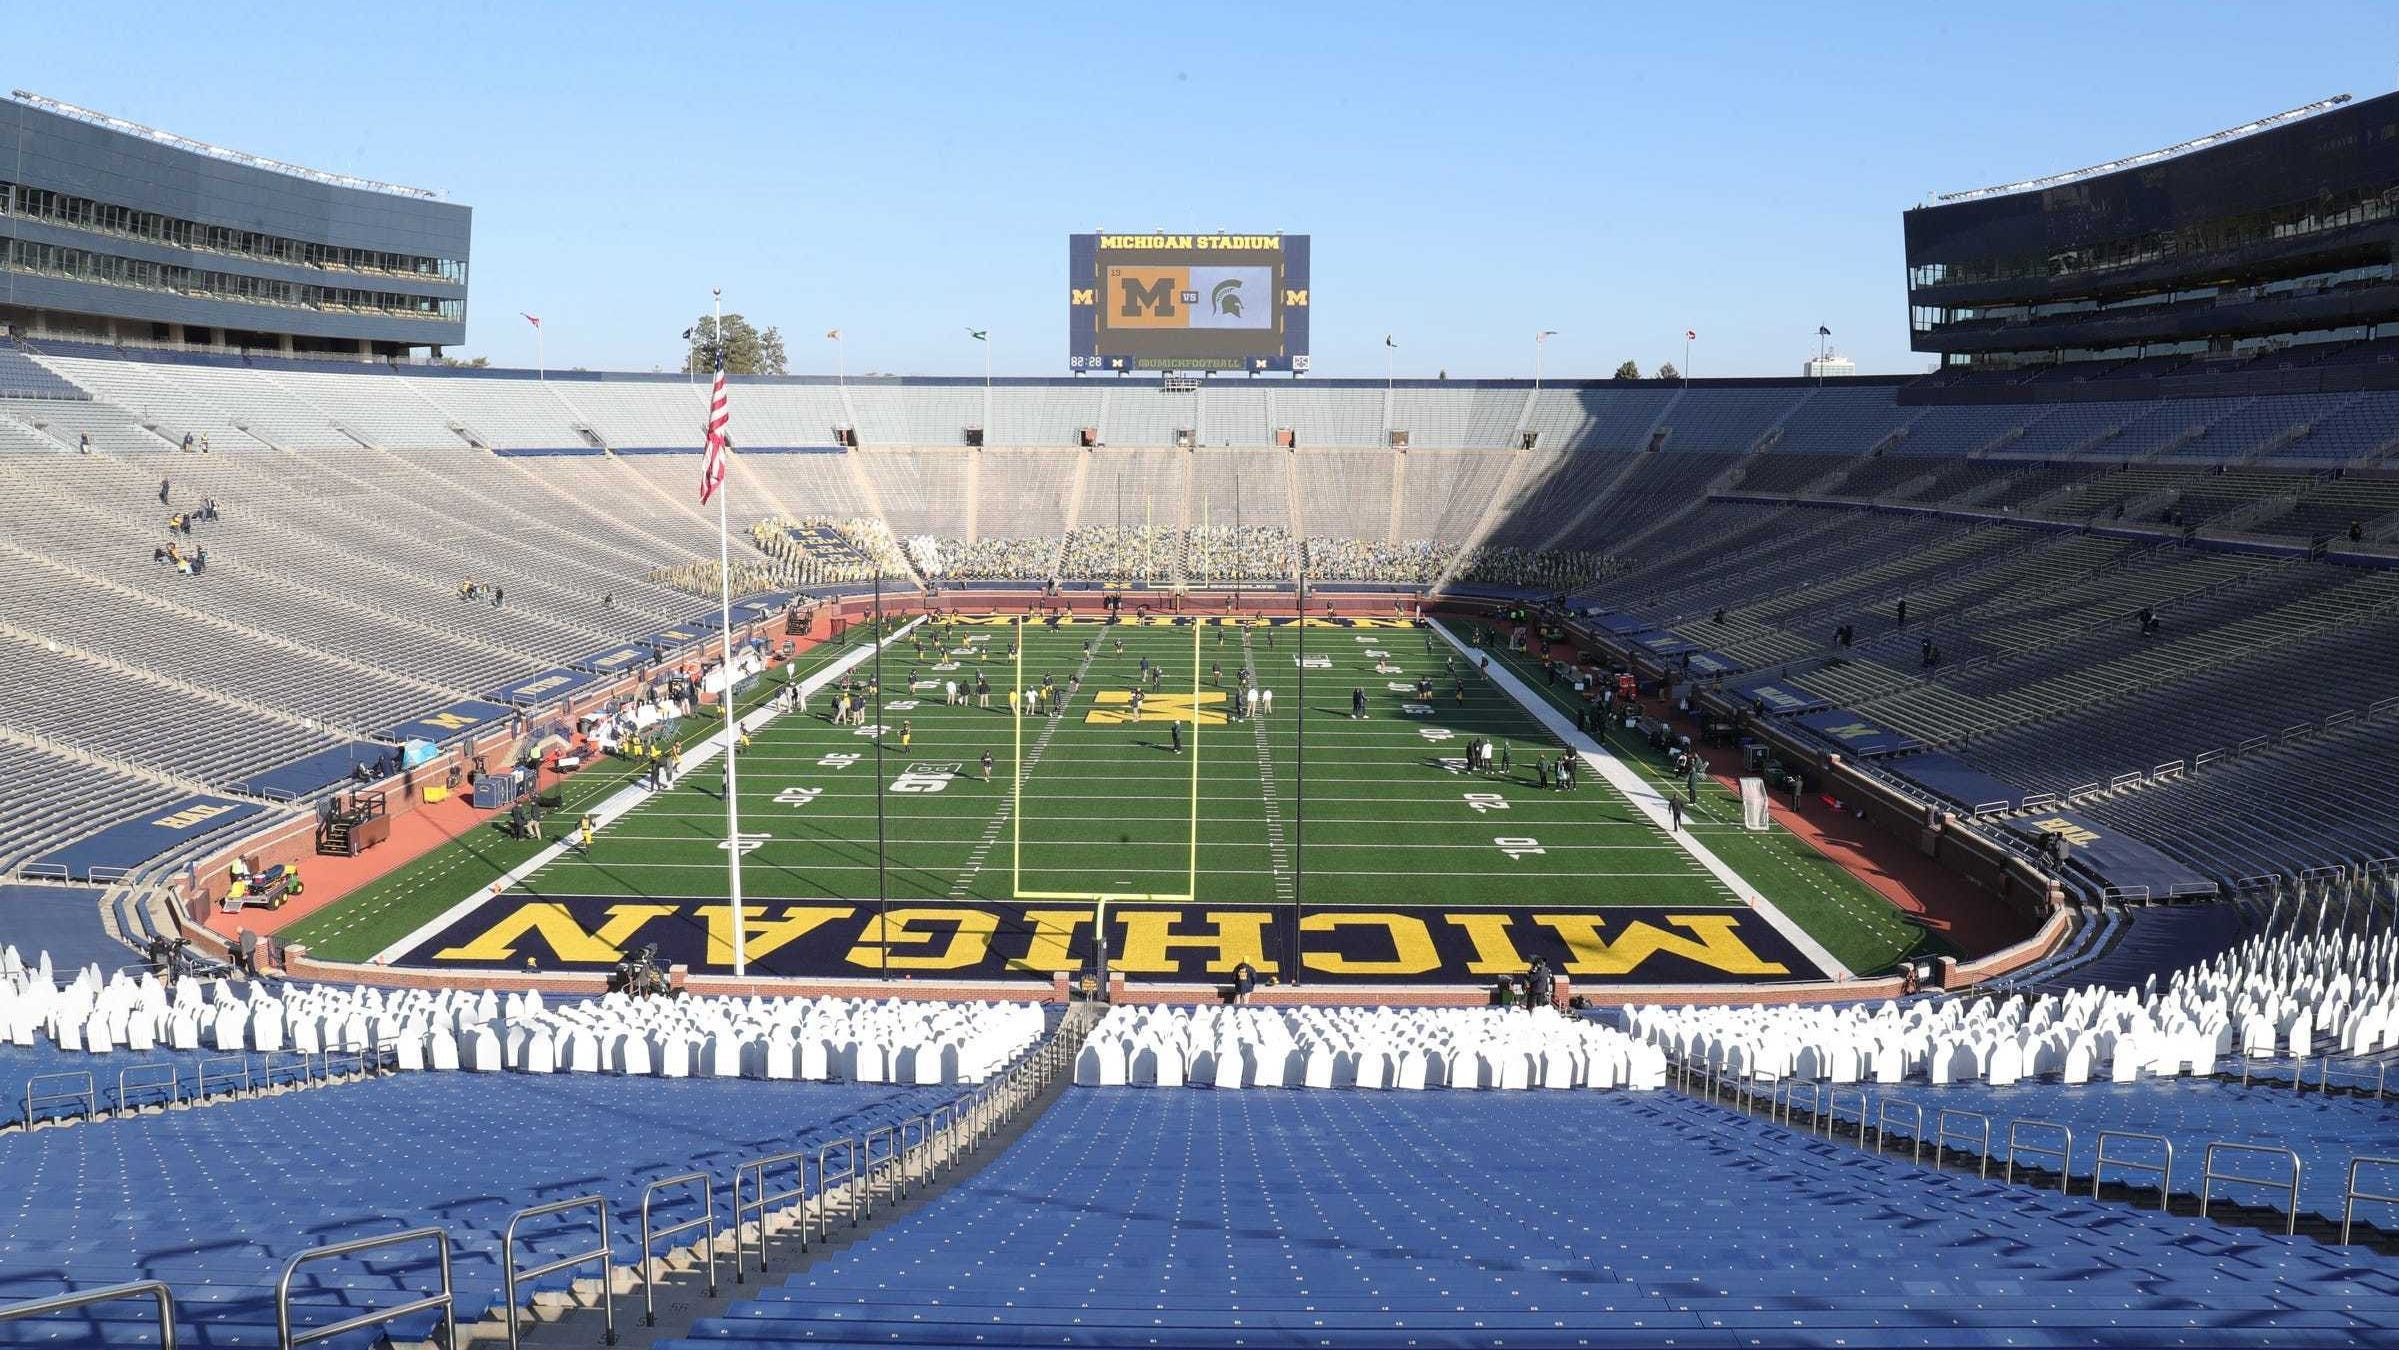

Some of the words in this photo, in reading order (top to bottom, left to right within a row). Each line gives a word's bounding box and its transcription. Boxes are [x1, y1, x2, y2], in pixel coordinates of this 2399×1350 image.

[1100, 236, 1192, 249] MICHIGAN
[1197, 236, 1280, 249] STADIUM
[1072, 289, 1093, 305] M
[1121, 278, 1175, 317] M
[1183, 293, 1197, 302] VS
[1286, 290, 1308, 306] M
[432, 902, 1792, 975] MICHIGAN
